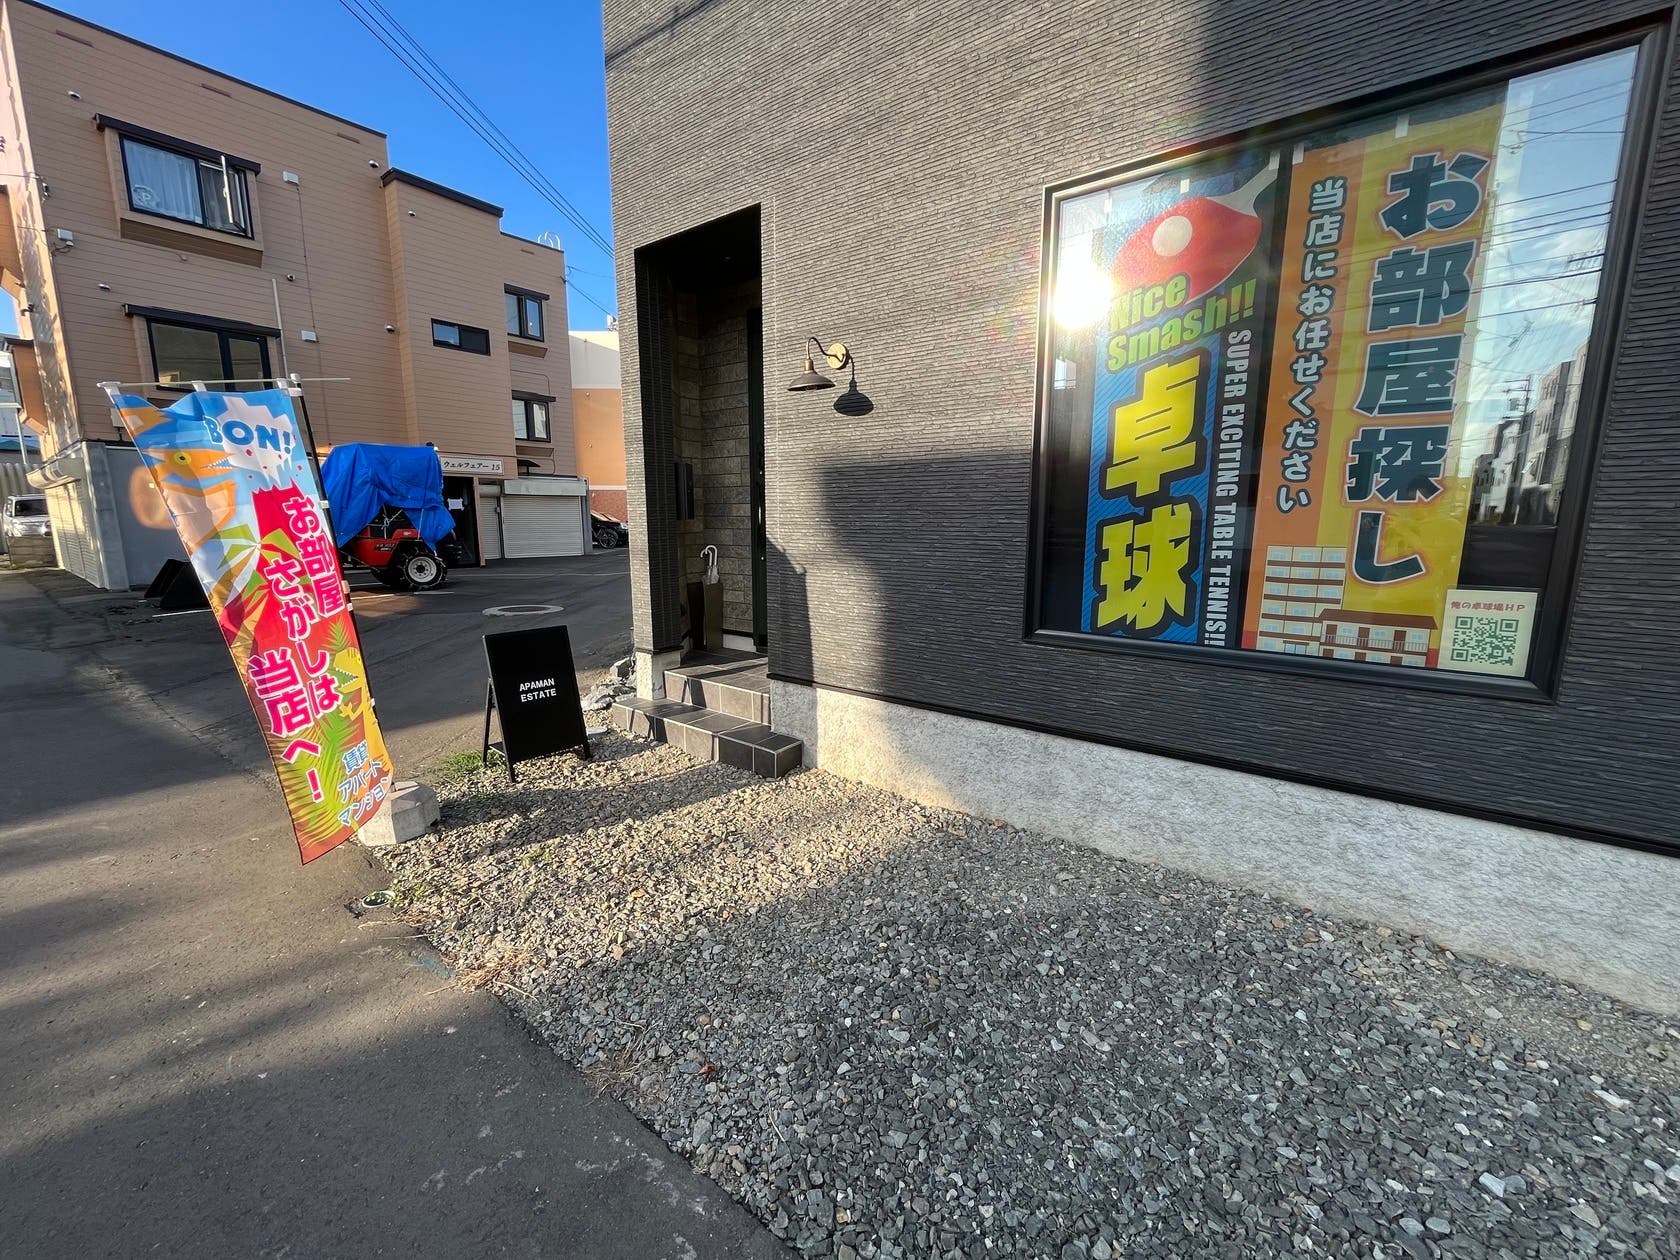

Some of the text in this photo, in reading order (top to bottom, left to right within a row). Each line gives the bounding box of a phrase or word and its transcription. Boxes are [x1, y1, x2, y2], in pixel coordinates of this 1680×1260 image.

[1109, 274, 1188, 333] Nice
[1278, 178, 1344, 512] 当店にお任せください
[1345, 152, 1488, 584] お部屋探し
[203, 415, 292, 456] BON!
[491, 463, 500, 471] 15
[1097, 354, 1201, 631] 卓球
[1204, 329, 1252, 647] SUPER EXCITING TABLE TENNIS!!
[282, 495, 346, 618] お部屋
[263, 557, 343, 719] さがしは
[519, 677, 556, 692] APAMAN
[520, 688, 557, 703] ESTATE
[337, 759, 382, 804] アパート
[342, 740, 369, 775] 賃貸
